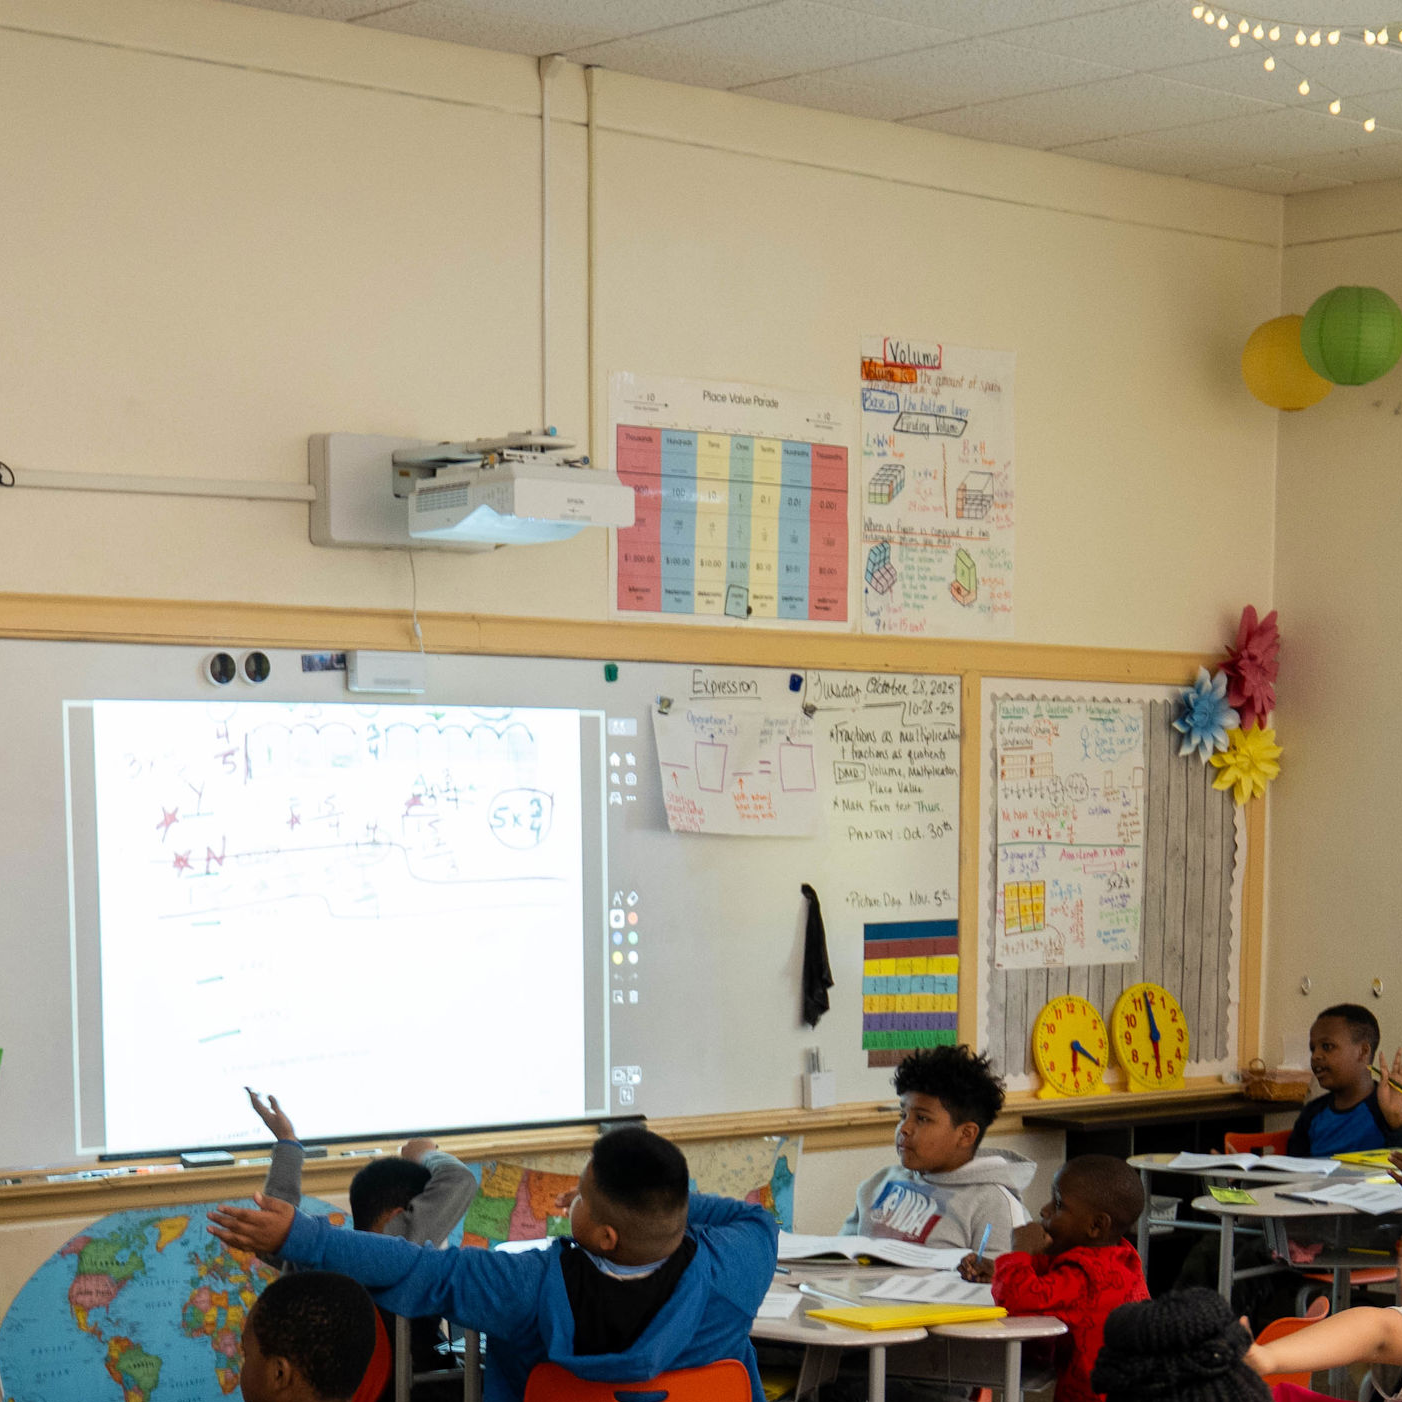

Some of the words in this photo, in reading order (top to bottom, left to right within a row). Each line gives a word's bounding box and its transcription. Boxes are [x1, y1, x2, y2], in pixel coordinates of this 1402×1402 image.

[889, 341, 939, 367] Volume
[935, 375, 964, 391] amount
[702, 390, 727, 403] Place
[729, 392, 752, 405] Value
[753, 395, 779, 409] Parade
[903, 394, 917, 411] the
[919, 396, 947, 414] bottom
[672, 488, 685, 497] 100
[692, 668, 758, 696] Expression
[866, 675, 908, 696] October
[930, 680, 956, 696] 2025
[882, 731, 893, 743] as
[892, 750, 902, 760] as
[868, 781, 893, 795] Place
[897, 782, 923, 794] Value
[1066, 1002, 1075, 1014] 12
[1132, 998, 1143, 1011] 11
[1160, 996, 1166, 1009] 1
[1054, 1009, 1062, 1020] 11
[1082, 1005, 1086, 1016] 1
[1170, 1008, 1178, 1022] 2
[1092, 1019, 1098, 1030] 2
[1125, 1014, 1137, 1028] 10
[1046, 1023, 1056, 1034] 10
[1177, 1028, 1184, 1042] 3
[1098, 1038, 1104, 1049] 3
[1124, 1031, 1132, 1045] 9
[1043, 1041, 1049, 1052] 9
[1131, 1049, 1139, 1063] 8
[1175, 1047, 1182, 1061] 4
[1049, 1061, 1055, 1072] 8
[1142, 1062, 1149, 1076] 7
[1167, 1060, 1174, 1075] 5
[1061, 1073, 1067, 1083] 7
[1074, 1077, 1080, 1088] 6
[1087, 1071, 1093, 1082] 5
